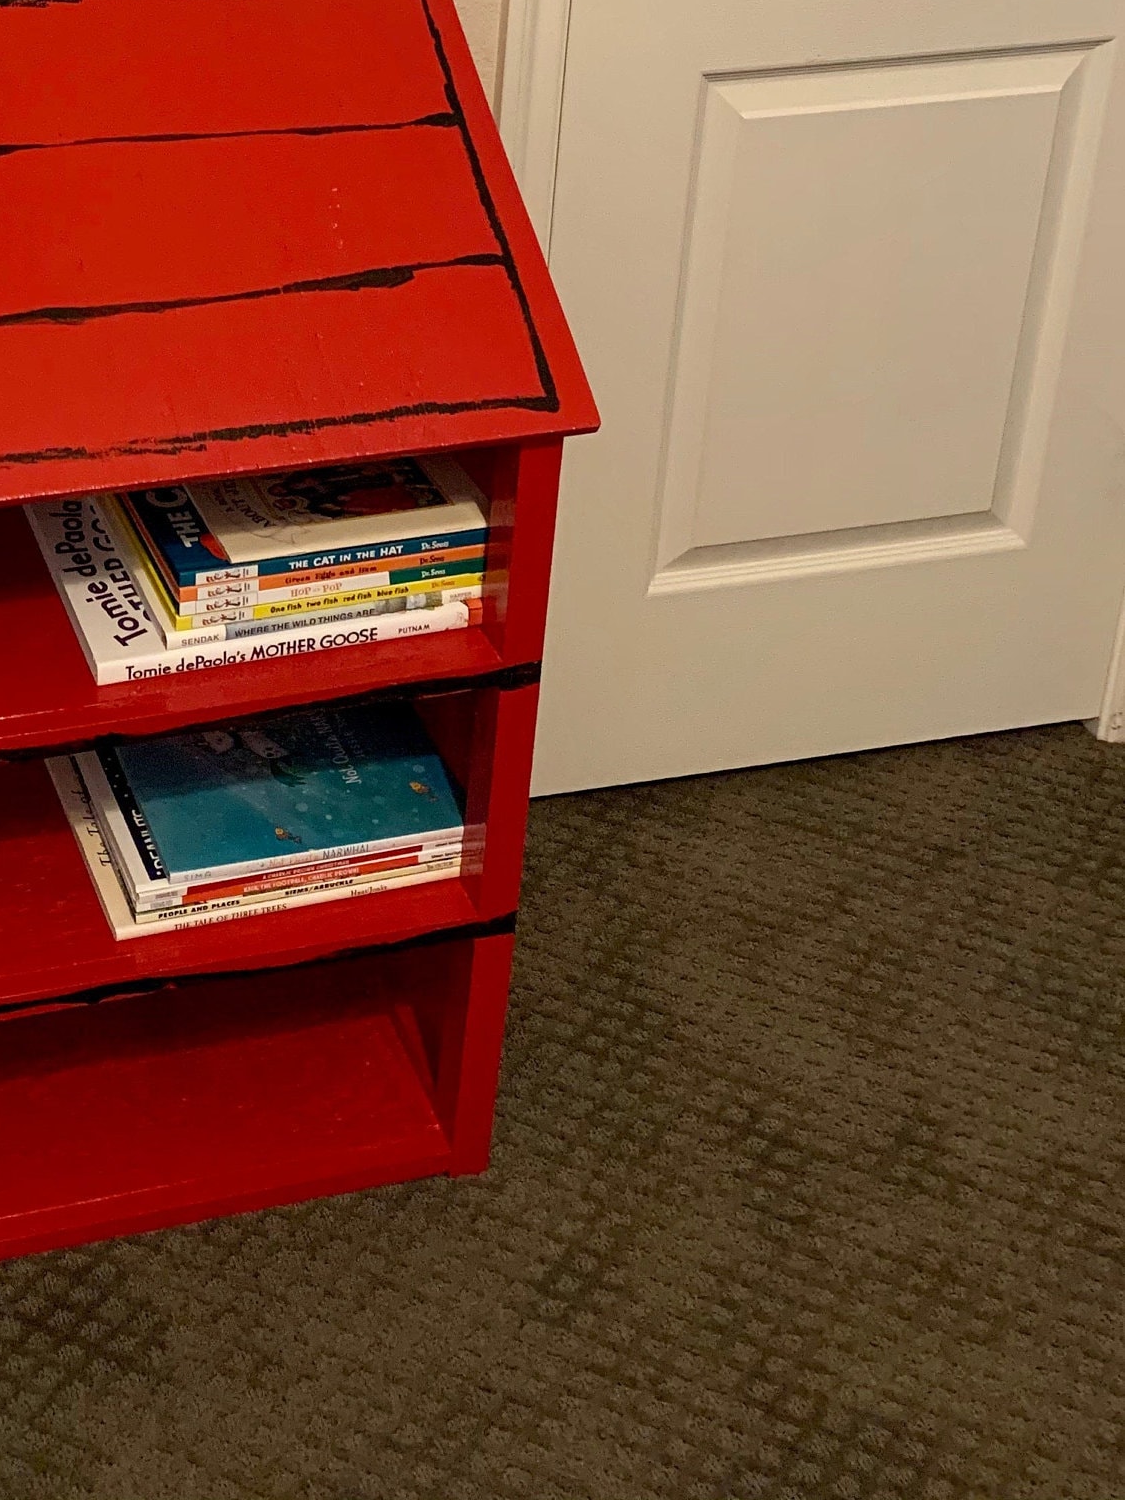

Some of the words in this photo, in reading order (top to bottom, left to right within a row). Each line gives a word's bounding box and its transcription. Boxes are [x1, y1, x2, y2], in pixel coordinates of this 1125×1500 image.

[166, 511, 201, 548] THE
[288, 560, 309, 570] THE
[313, 555, 336, 567] CAT
[339, 553, 352, 562] IN
[356, 550, 376, 559] THE
[380, 545, 404, 556] HAT
[431, 541, 450, 549] Seuss
[339, 568, 355, 576] and
[286, 603, 302, 611] fish
[323, 596, 339, 605] fish
[343, 594, 356, 603] red
[357, 592, 372, 600] fish
[376, 589, 393, 597] blue
[394, 586, 410, 595] fish
[86, 580, 148, 647] Tomie
[181, 634, 220, 646] SENDAK
[235, 625, 270, 638] WHERE
[270, 621, 290, 631] THE
[291, 618, 317, 629] WILD
[317, 612, 354, 624] THINGS
[355, 608, 376, 618] ARE
[125, 664, 172, 680] Tomie
[176, 651, 246, 672] dePaola's
[249, 637, 317, 661] MOTHER
[320, 627, 379, 650] GOOSE
[398, 624, 431, 634] PUTNAM
[339, 764, 362, 784] Not
[183, 871, 212, 880] SIMA
[322, 844, 370, 859] NARWHAL
[158, 909, 188, 919] PEOPLE
[191, 905, 209, 913] AND
[211, 900, 241, 910] PLACES
[175, 922, 191, 930] THE
[194, 917, 214, 927] TALE
[216, 914, 229, 922] OF
[231, 909, 261, 920] THREE
[262, 903, 288, 914] TREES
